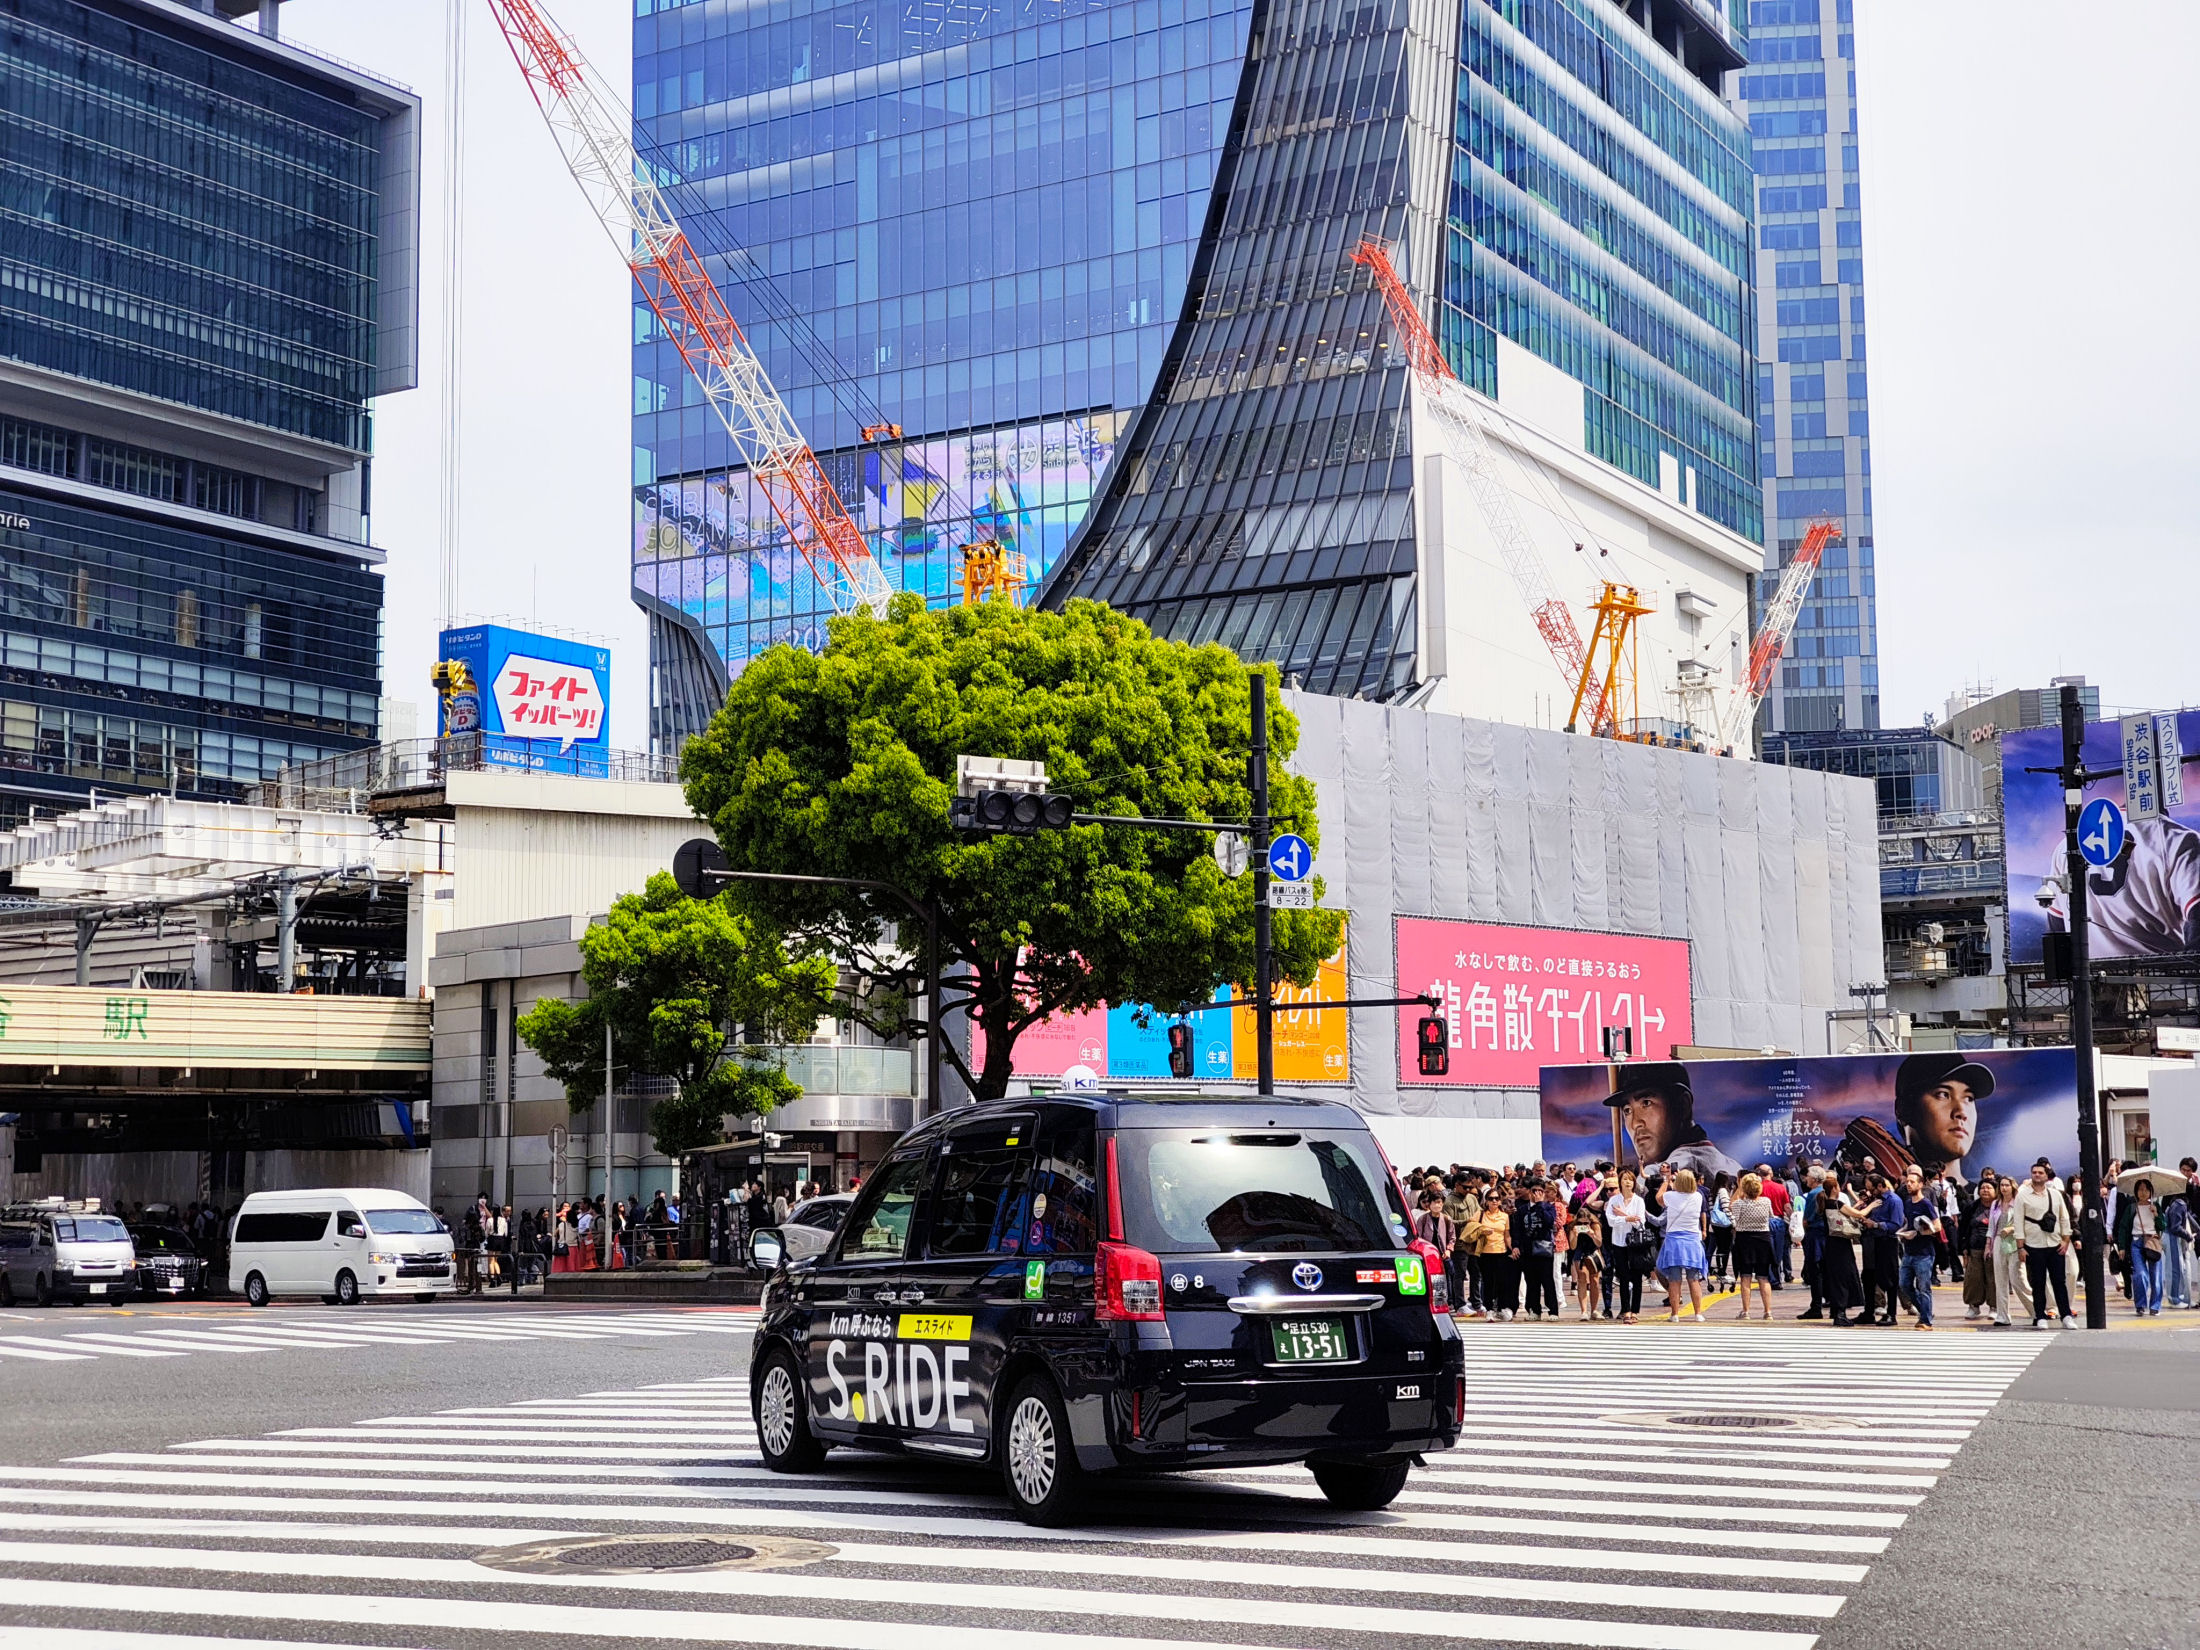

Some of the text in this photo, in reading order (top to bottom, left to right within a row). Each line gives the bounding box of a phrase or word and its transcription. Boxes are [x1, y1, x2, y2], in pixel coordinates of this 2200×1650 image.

[645, 483, 747, 522] SHIBUYA
[645, 509, 779, 552] SCRAMBLE
[508, 671, 588, 702] ファイト
[2134, 722, 2154, 813] 渋谷駅前
[2162, 719, 2180, 804] スクランブル式
[2126, 738, 2137, 804] Shibuya Sta.
[1455, 950, 1642, 980] 水なしで飲む、のど直接うるおう
[1081, 1048, 1102, 1061] 生薬
[1208, 1051, 1228, 1064] 生薬
[1325, 1054, 1343, 1067] 生薬
[1761, 1119, 1826, 1137] 挑戦を支える、
[1762, 1138, 1827, 1155] 安心をつくる。
[1194, 1275, 1204, 1289] 8
[847, 1286, 861, 1299] km
[1057, 1312, 1077, 1324] 1351
[915, 1320, 954, 1335] エスライド
[1292, 1335, 1342, 1359] 13-51
[1209, 1359, 1236, 1368] TAXI
[827, 1339, 975, 1433] S.RIDE
[1396, 1385, 1420, 1399] km
